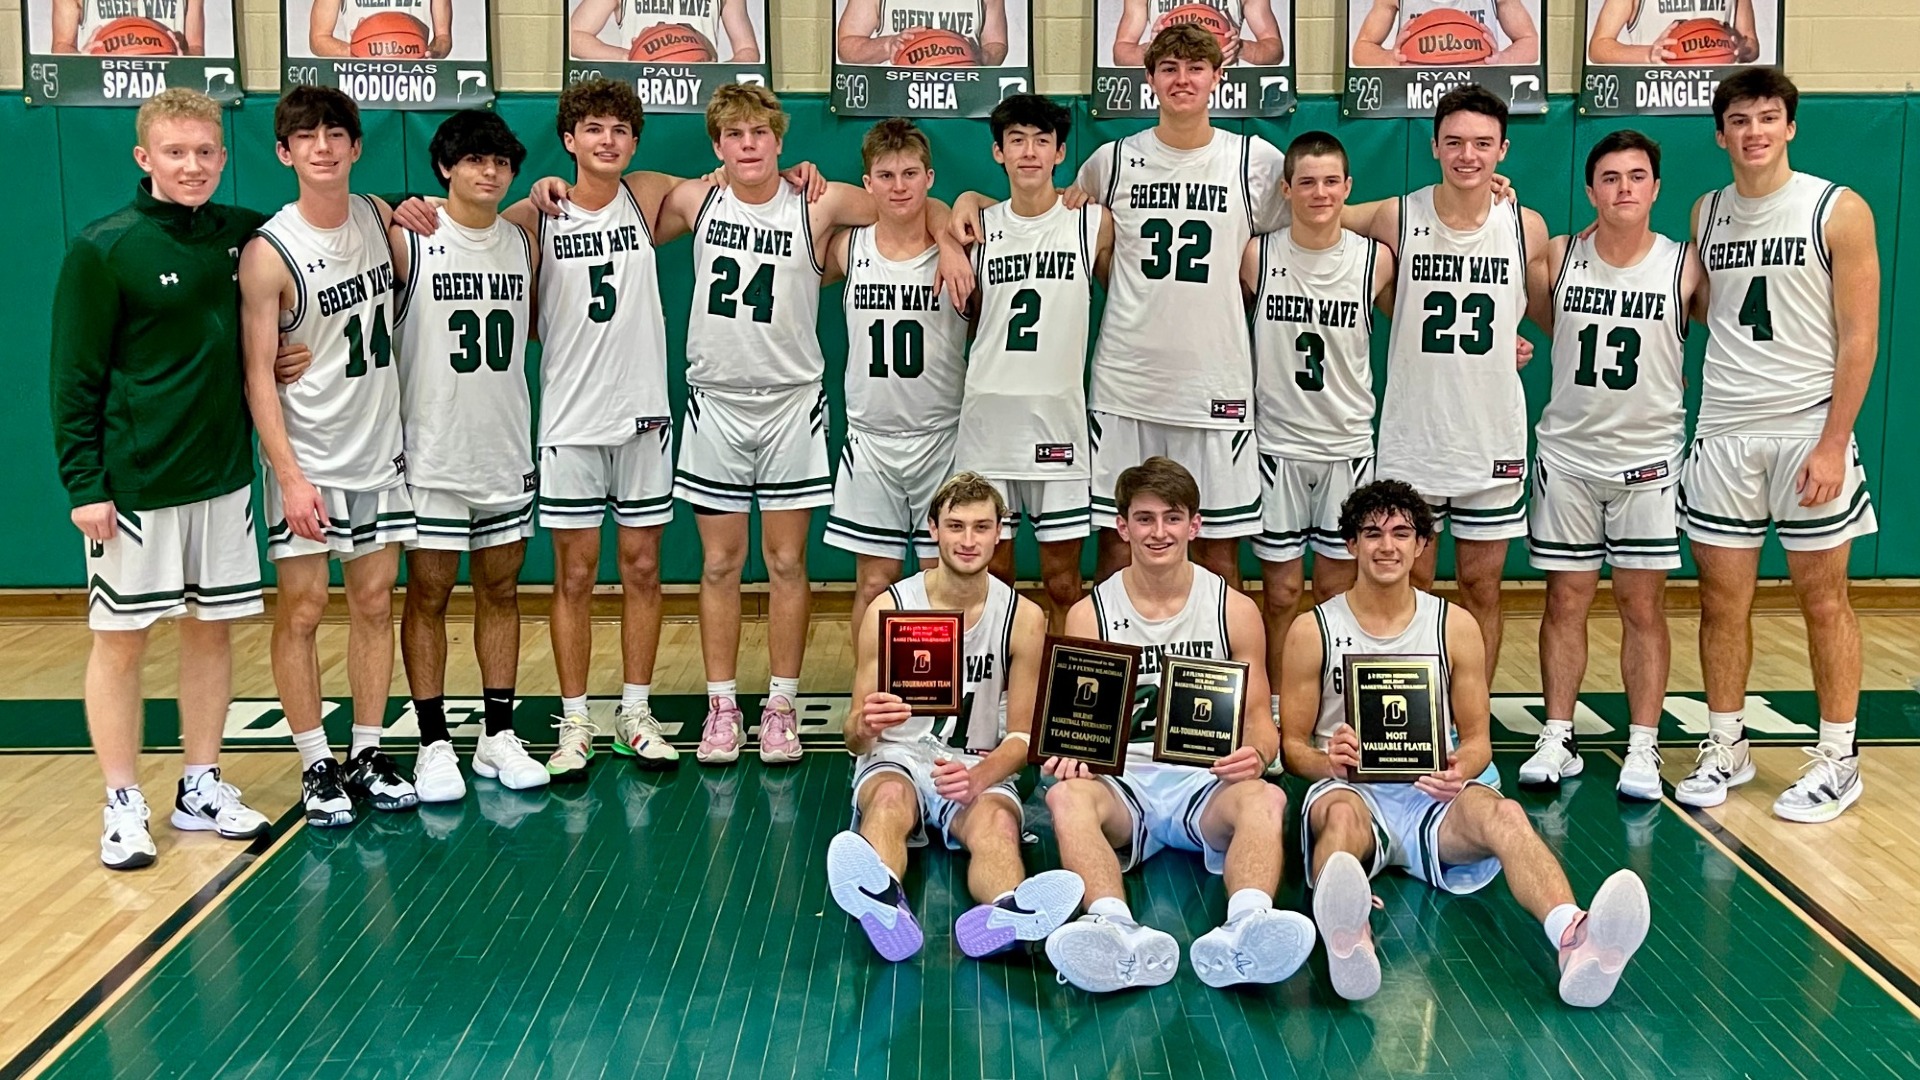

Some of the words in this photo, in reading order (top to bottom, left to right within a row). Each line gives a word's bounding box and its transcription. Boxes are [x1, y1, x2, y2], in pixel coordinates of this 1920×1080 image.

[938, 12, 973, 34] WAVE
[103, 34, 163, 53] Wilson
[368, 41, 420, 56] Wilson
[643, 34, 700, 55] Wilson
[906, 43, 966, 65] Wilson
[1418, 33, 1483, 55] Wilson
[1682, 35, 1731, 53] Wilson
[101, 60, 170, 70] BRETT
[333, 62, 438, 74] NICHOLAS
[643, 67, 696, 77] PAUL
[886, 71, 980, 82] SPENCER
[1416, 70, 1471, 81] RYAN
[1645, 69, 1715, 80] GRANT
[103, 71, 168, 99] SPADA
[339, 74, 436, 103] MODUGNO
[637, 78, 702, 106] BRADY
[836, 73, 869, 109] #13
[907, 83, 958, 110] SHEA
[1097, 76, 1132, 111] #22
[1349, 77, 1383, 111] #23
[1586, 74, 1619, 109] #32
[1130, 183, 1182, 210] GREEN
[1186, 183, 1228, 213] WAVE
[554, 230, 603, 260] GREEN
[605, 225, 639, 254] WAVE
[706, 218, 749, 250] GREEN
[753, 228, 793, 257] WAVE
[1141, 218, 1212, 284] 32
[988, 255, 1031, 286] GREEN
[1035, 251, 1076, 281] WAVE
[1412, 253, 1464, 283] GREEN
[1469, 256, 1509, 285] WAVE
[1710, 242, 1757, 272] GREEN
[1761, 237, 1806, 267] WAVE
[318, 274, 368, 317] GREEN
[433, 273, 484, 301] GREEN
[487, 273, 524, 301] WAVE
[588, 261, 616, 323] 5
[708, 255, 775, 324] 24
[854, 284, 896, 311] GREEN
[901, 284, 941, 311] WAVE
[1266, 294, 1314, 324] GREEN
[1318, 299, 1359, 328] WAVE
[1563, 285, 1617, 316] GREEN
[1620, 290, 1666, 321] WAVE
[1738, 275, 1774, 342] 4
[1005, 288, 1041, 352] 2
[1421, 290, 1496, 356] 23
[344, 303, 392, 378] 14
[448, 309, 514, 374] 30
[868, 319, 925, 379] 10
[1295, 331, 1325, 392] 3
[1574, 323, 1641, 391] 13
[1051, 729, 1070, 739] TEAM
[1071, 732, 1111, 744] CHAMPION
[1216, 731, 1231, 740] TEAM
[1363, 742, 1402, 751] VALUABLE
[1404, 742, 1432, 751] PLAYER
[1385, 731, 1408, 740] MOST
